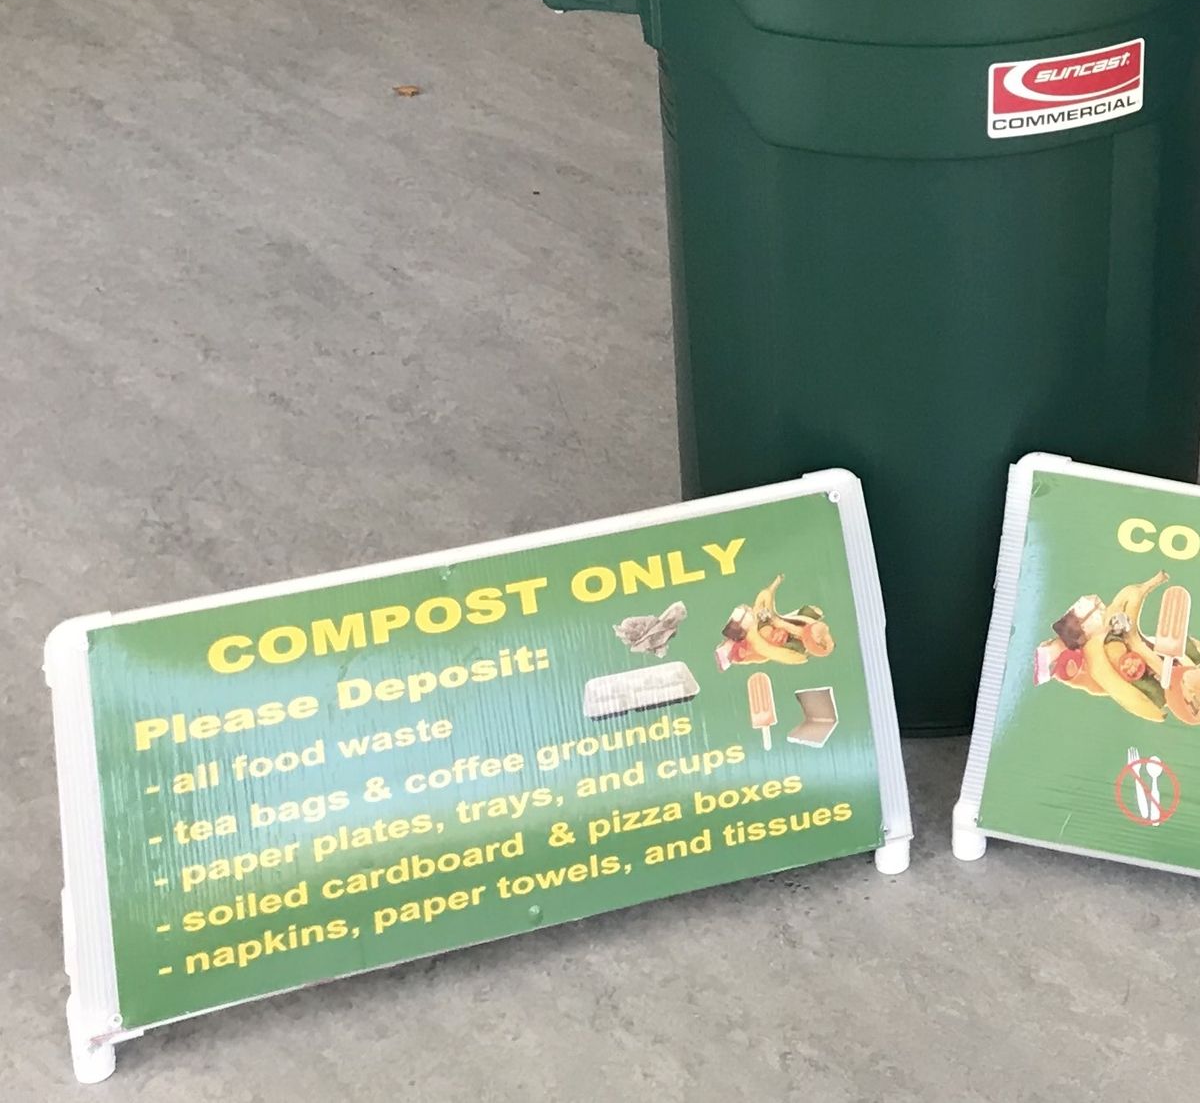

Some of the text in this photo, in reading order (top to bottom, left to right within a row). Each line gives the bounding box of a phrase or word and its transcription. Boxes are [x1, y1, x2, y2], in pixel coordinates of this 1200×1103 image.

[992, 96, 1136, 131] COMMERCIAL
[207, 538, 745, 674] COMPOST ONLY
[134, 645, 550, 751] Please Deposit:
[173, 761, 220, 794] all
[231, 739, 326, 781] food
[337, 719, 453, 758] waste
[173, 814, 237, 845] tea
[250, 790, 350, 828] bags
[363, 776, 392, 803] &
[405, 752, 524, 794] coffee
[536, 715, 692, 772] grounds
[181, 842, 300, 893] paper
[313, 813, 444, 863] plates,
[455, 787, 564, 824] trays,
[576, 761, 645, 798] and
[657, 745, 745, 779] cups
[182, 880, 309, 932] soiled
[321, 831, 524, 899] cardboard
[548, 821, 576, 847] &
[588, 802, 682, 845] pizza
[694, 775, 803, 815] boxes
[185, 919, 360, 974] napkins,
[374, 885, 486, 935] paper
[496, 854, 632, 899] towels,
[644, 828, 712, 865] and
[722, 803, 853, 847] tissues
